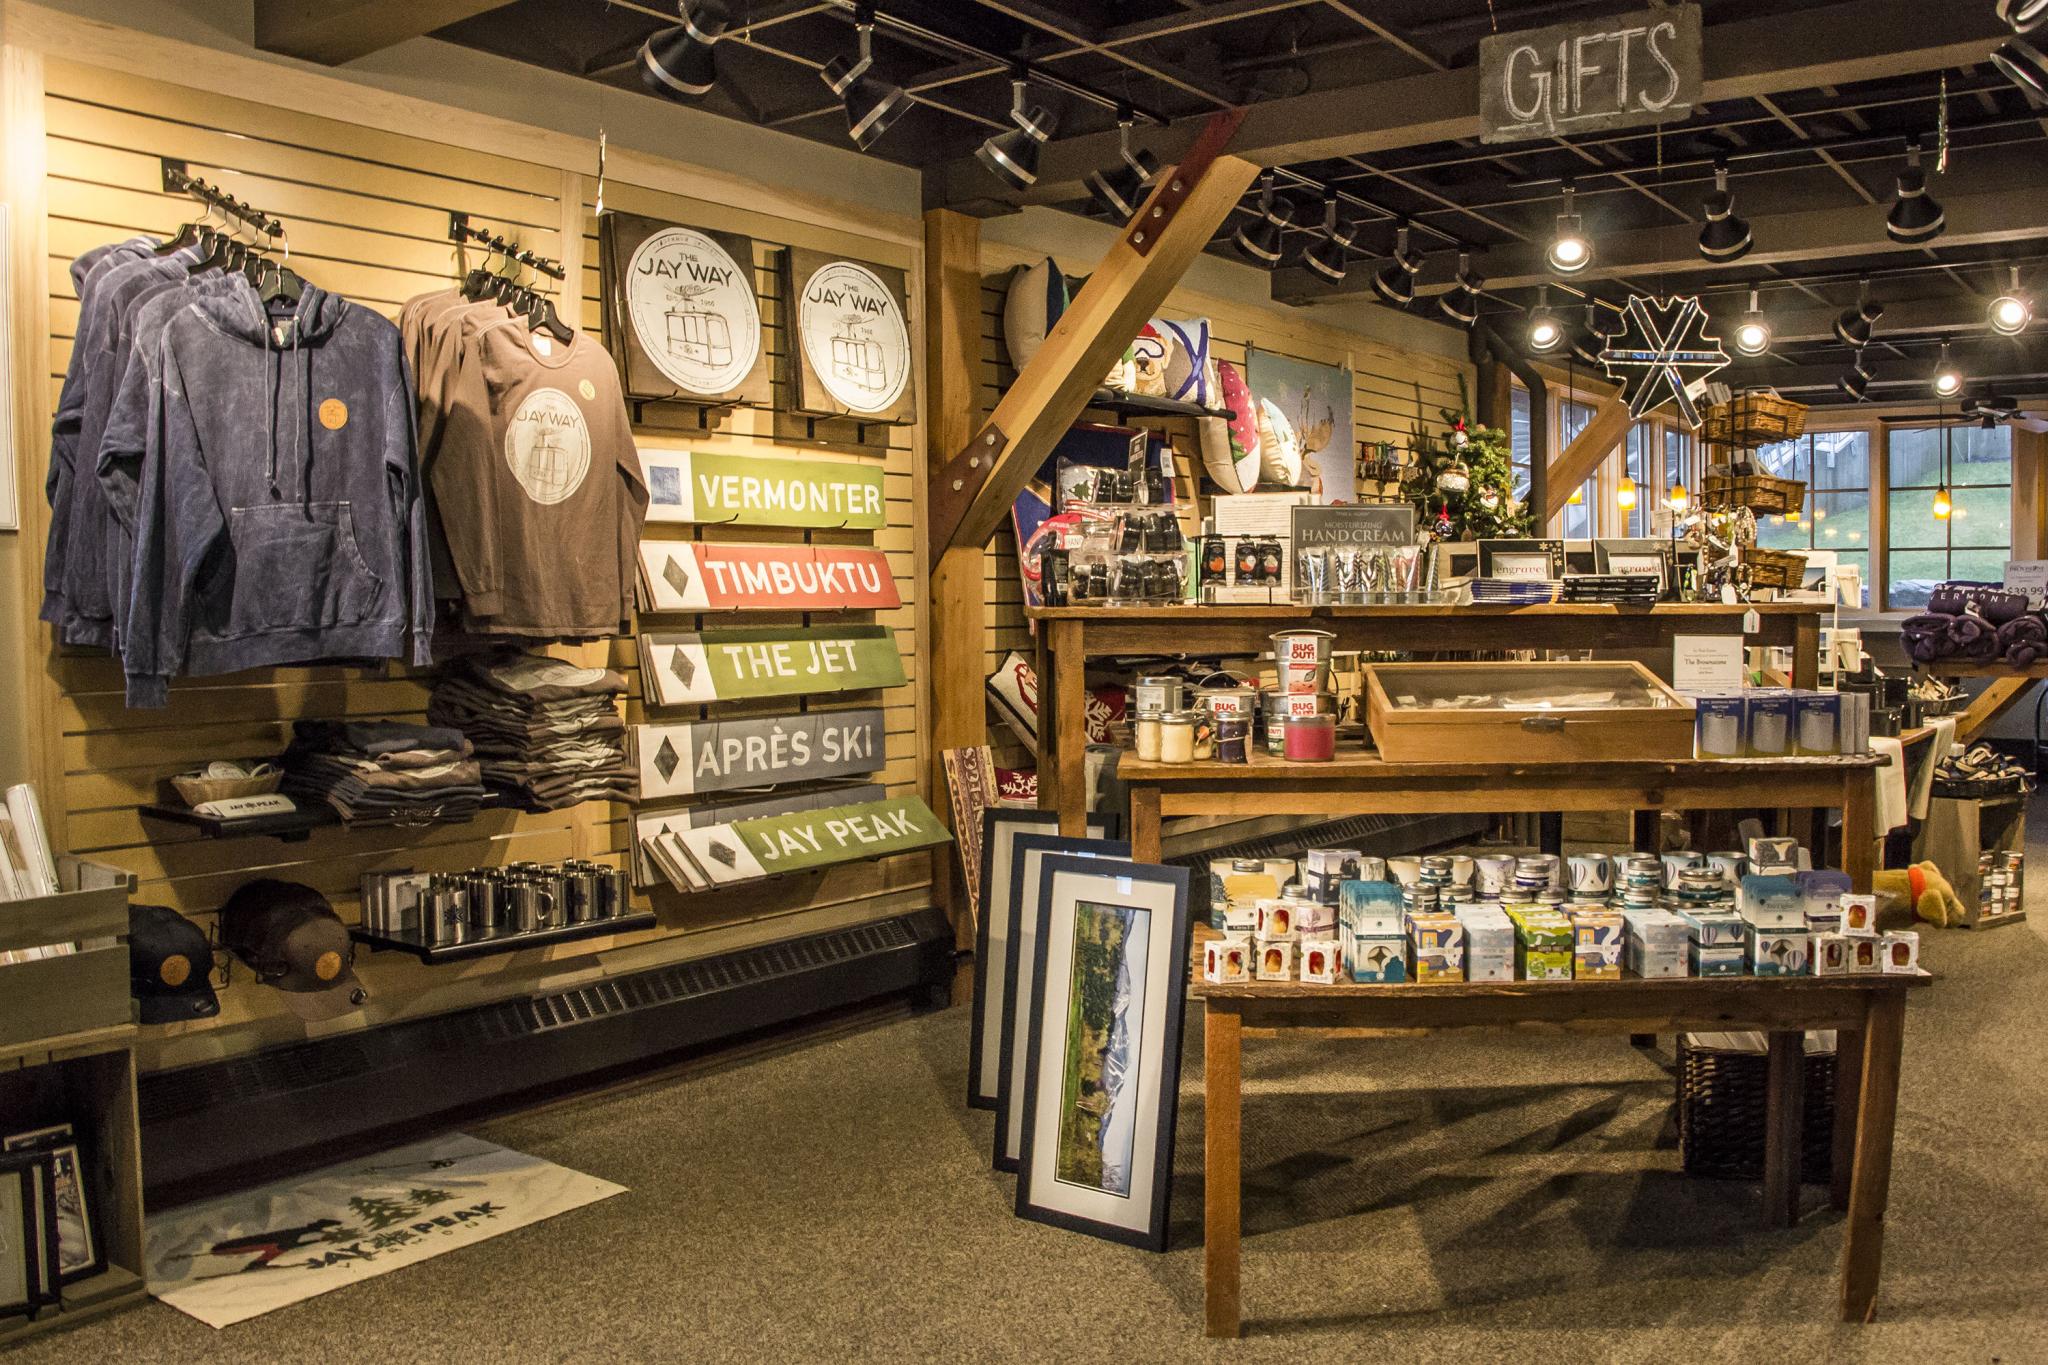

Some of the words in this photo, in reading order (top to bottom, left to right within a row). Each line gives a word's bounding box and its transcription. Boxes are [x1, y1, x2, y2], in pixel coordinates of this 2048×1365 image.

[1503, 22, 1679, 135] GIFTS
[679, 252, 698, 263] THE
[638, 258, 682, 279] JAY
[687, 262, 733, 287] WAY
[843, 283, 859, 293] THE
[809, 288, 846, 308] JAY
[850, 293, 888, 316] WAY
[516, 411, 546, 424] JAY
[549, 412, 579, 428] WAY
[699, 473, 882, 515] VERMONTER
[1324, 521, 1383, 529] MOISTURIZING
[1302, 529, 1350, 542] HAND
[1351, 529, 1405, 542] CREAM
[704, 560, 881, 595] TIMBUKTU
[2007, 586, 2044, 595] $39.99
[1291, 651, 1315, 659] OUT!
[1292, 643, 1315, 652] BUG
[723, 645, 797, 680] THE
[806, 639, 858, 675] JET
[1214, 703, 1237, 712] BUG
[1291, 703, 1314, 711] BUG
[695, 726, 811, 778] APRÈS
[822, 725, 873, 763] SKI
[764, 824, 822, 860] JAY
[824, 808, 922, 847] PEAK
[306, 1242, 381, 1270] JAY
[410, 1201, 506, 1234] PEAK
